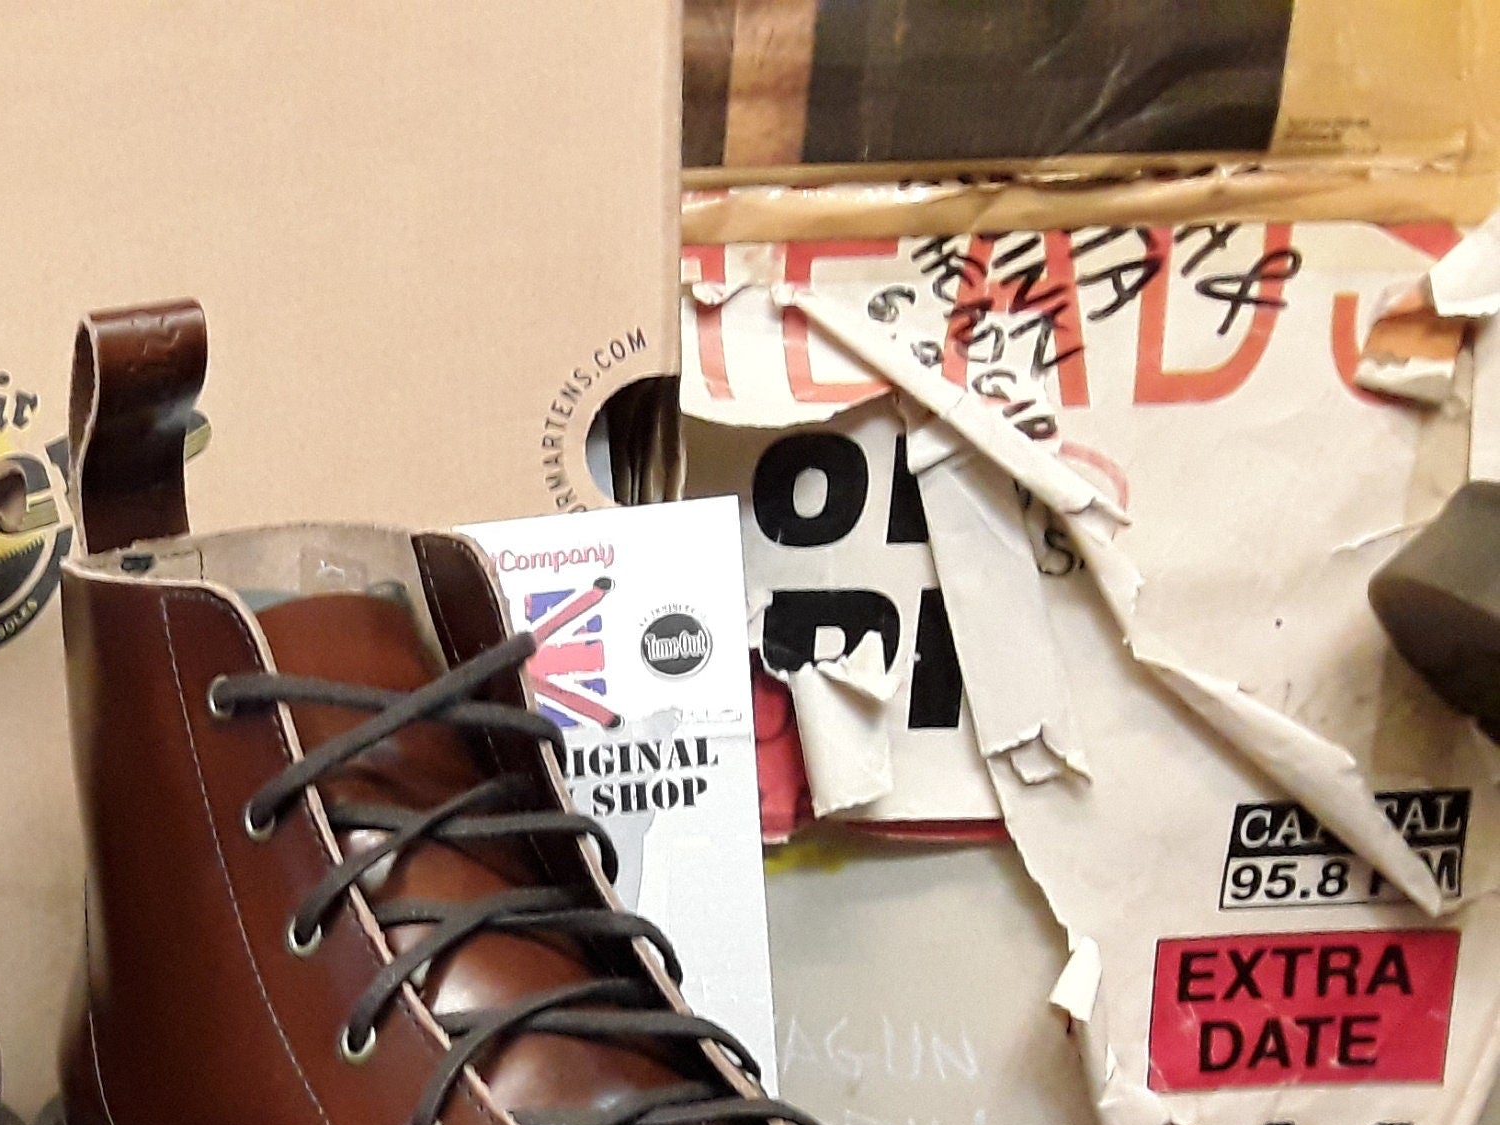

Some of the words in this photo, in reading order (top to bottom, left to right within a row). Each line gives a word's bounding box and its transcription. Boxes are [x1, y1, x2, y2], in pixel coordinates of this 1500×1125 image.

[591, 775, 709, 818] SHOP
[1230, 859, 1350, 900] 95.8
[1177, 944, 1414, 1004] EXTRA
[1199, 1013, 1380, 1074] DATE
